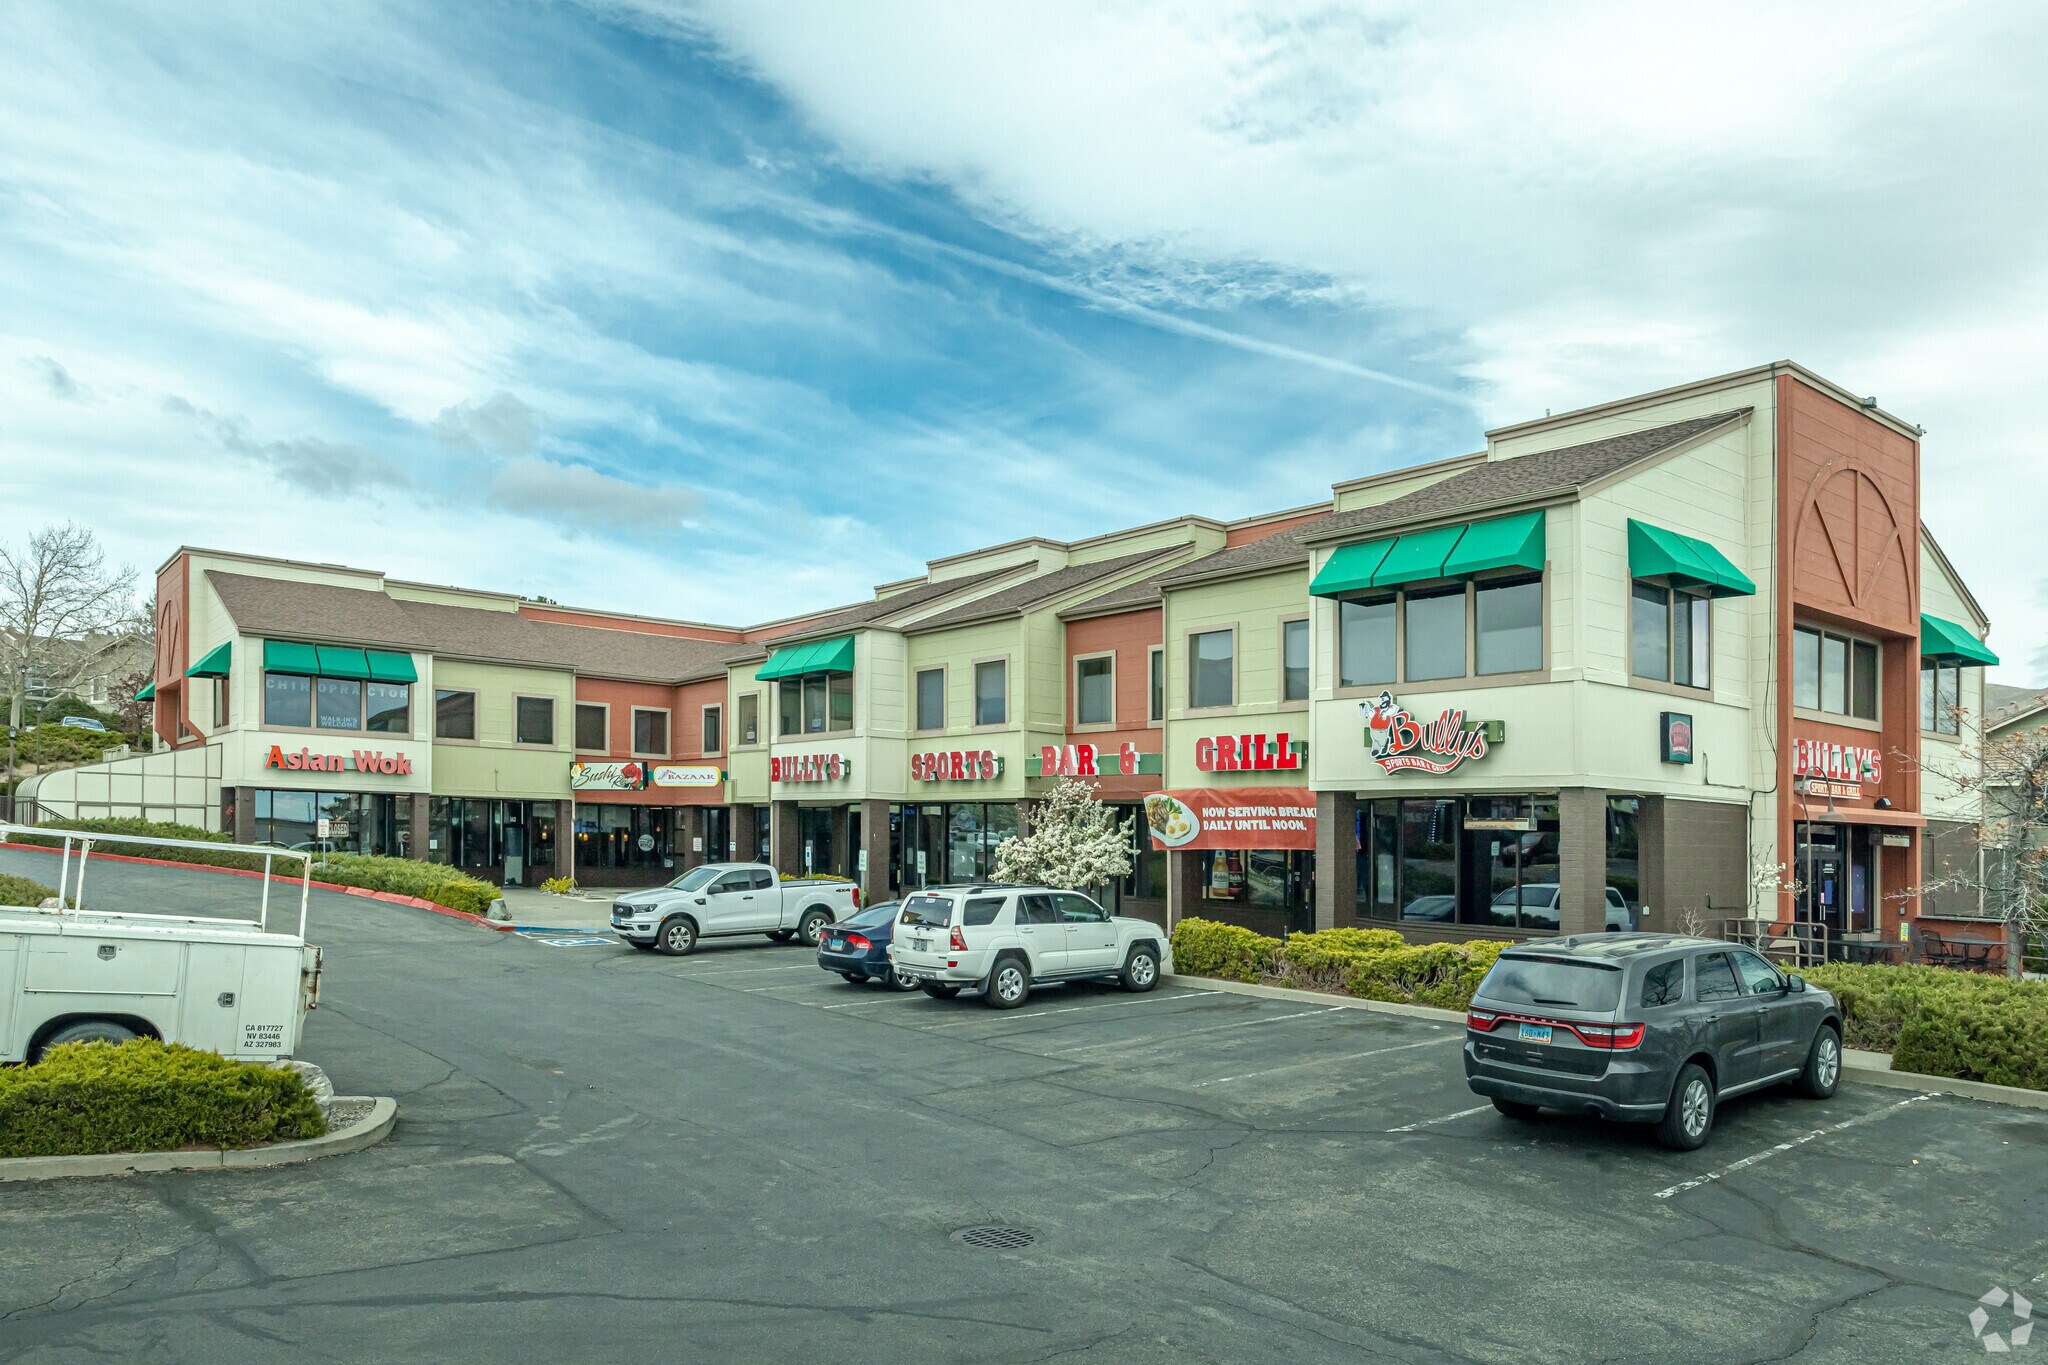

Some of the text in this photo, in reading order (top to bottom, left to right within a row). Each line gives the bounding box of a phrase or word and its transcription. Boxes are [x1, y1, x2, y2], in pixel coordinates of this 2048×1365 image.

[267, 679, 408, 699] CHIROPRACTOR
[321, 720, 358, 729] WELCOME
[1389, 708, 1485, 760] Bully's
[265, 745, 413, 775] Asian Wok
[1041, 742, 1138, 776] BAR &
[1195, 732, 1300, 771] GRILL
[1385, 758, 1411, 769] SPORTS
[1411, 758, 1426, 769] BAR
[1797, 738, 1881, 784] BULLY'S
[573, 764, 618, 788] Sushi
[771, 753, 841, 782] BULLY'S
[911, 750, 994, 781] SPORTS
[1832, 784, 1841, 795] BAR
[1202, 807, 1226, 817] NOW
[1228, 806, 1277, 817] SERVING
[1203, 819, 1307, 830] DAILY UNTIL NOON.
